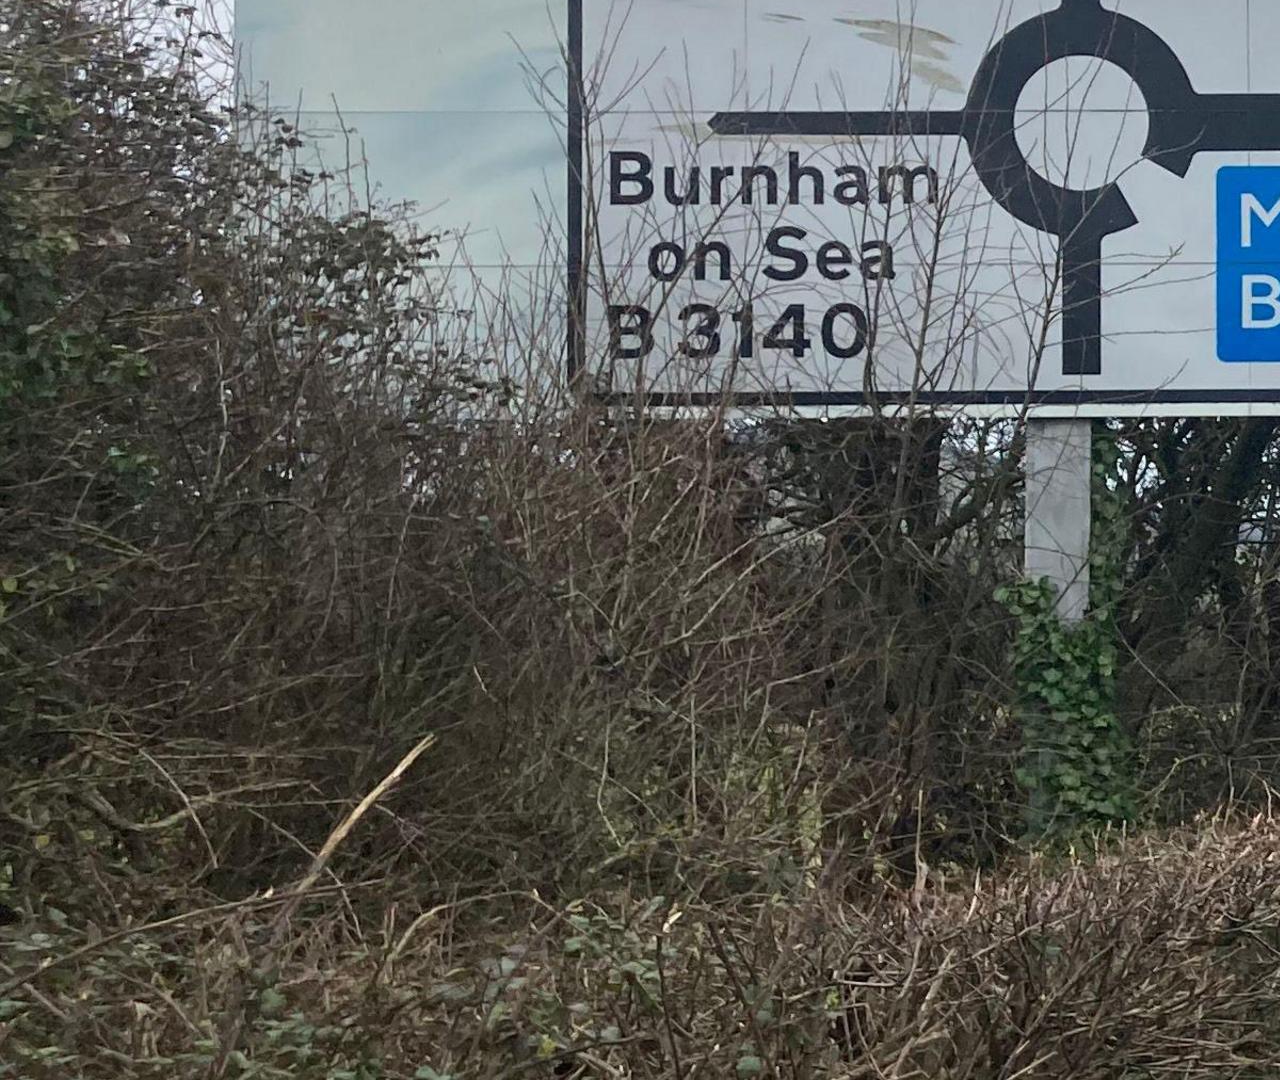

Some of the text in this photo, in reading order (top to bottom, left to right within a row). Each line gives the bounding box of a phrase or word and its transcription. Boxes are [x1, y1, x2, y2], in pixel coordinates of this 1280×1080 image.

[609, 151, 939, 206] Burnham
[647, 225, 897, 282] on Sea
